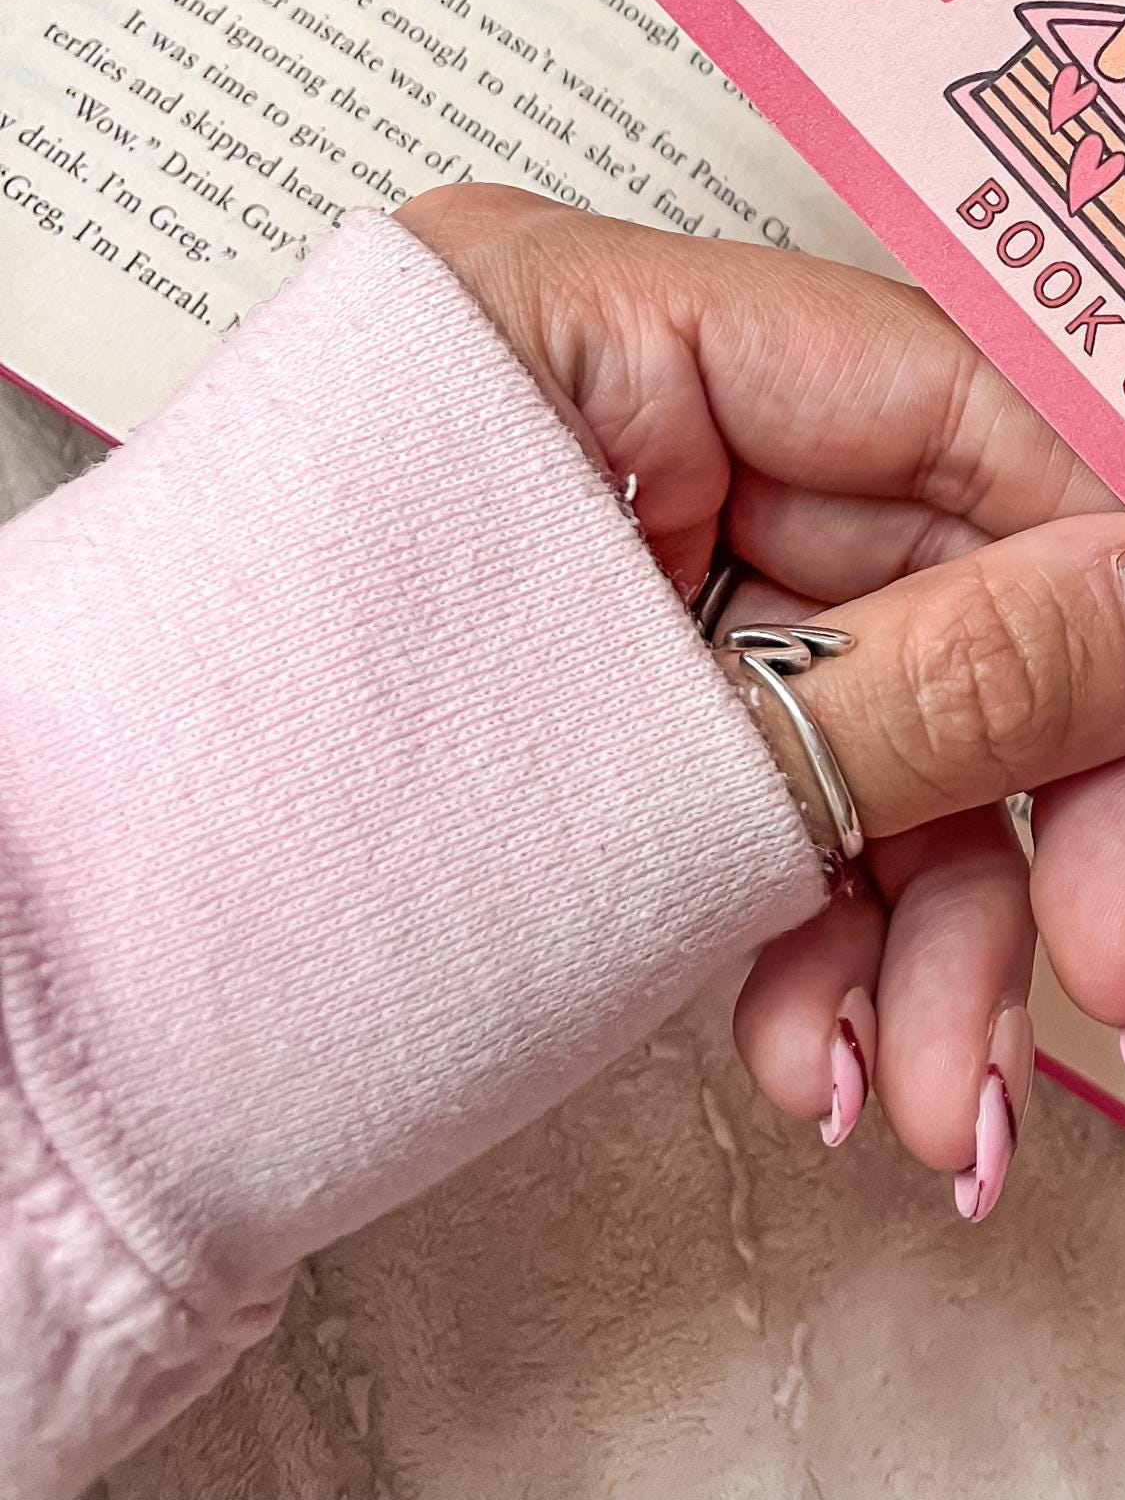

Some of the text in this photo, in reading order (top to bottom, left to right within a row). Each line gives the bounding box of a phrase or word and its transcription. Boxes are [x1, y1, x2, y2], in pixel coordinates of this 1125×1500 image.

[42, 22, 347, 229] terflies and skipped heart
[119, 8, 148, 38] It
[151, 30, 200, 70] was
[201, 63, 259, 108] time
[261, 102, 290, 128] to
[288, 123, 347, 165] give
[350, 160, 415, 204] othe
[223, 14, 328, 99] ignoring
[329, 86, 371, 122] the
[371, 116, 423, 156] rest
[423, 150, 462, 176] of
[287, 6, 384, 73] mistake
[389, 67, 437, 109] was
[439, 100, 523, 164] tunnel
[380, 7, 469, 73] enough
[477, 69, 505, 96] to
[512, 92, 577, 147] think
[583, 144, 652, 196] she'd
[650, 188, 705, 235] find
[479, 13, 557, 75] wasn't
[561, 67, 648, 143] waiting
[648, 130, 688, 167] for
[688, 157, 758, 224] Prince
[689, 51, 714, 76] to
[17, 124, 89, 184] drink.
[95, 170, 143, 215] I'm
[64, 86, 312, 263] "Wow." Drink Guy's
[71, 217, 120, 264] I'm
[121, 249, 211, 327] Farrah.
[955, 176, 1125, 357] BOOK
